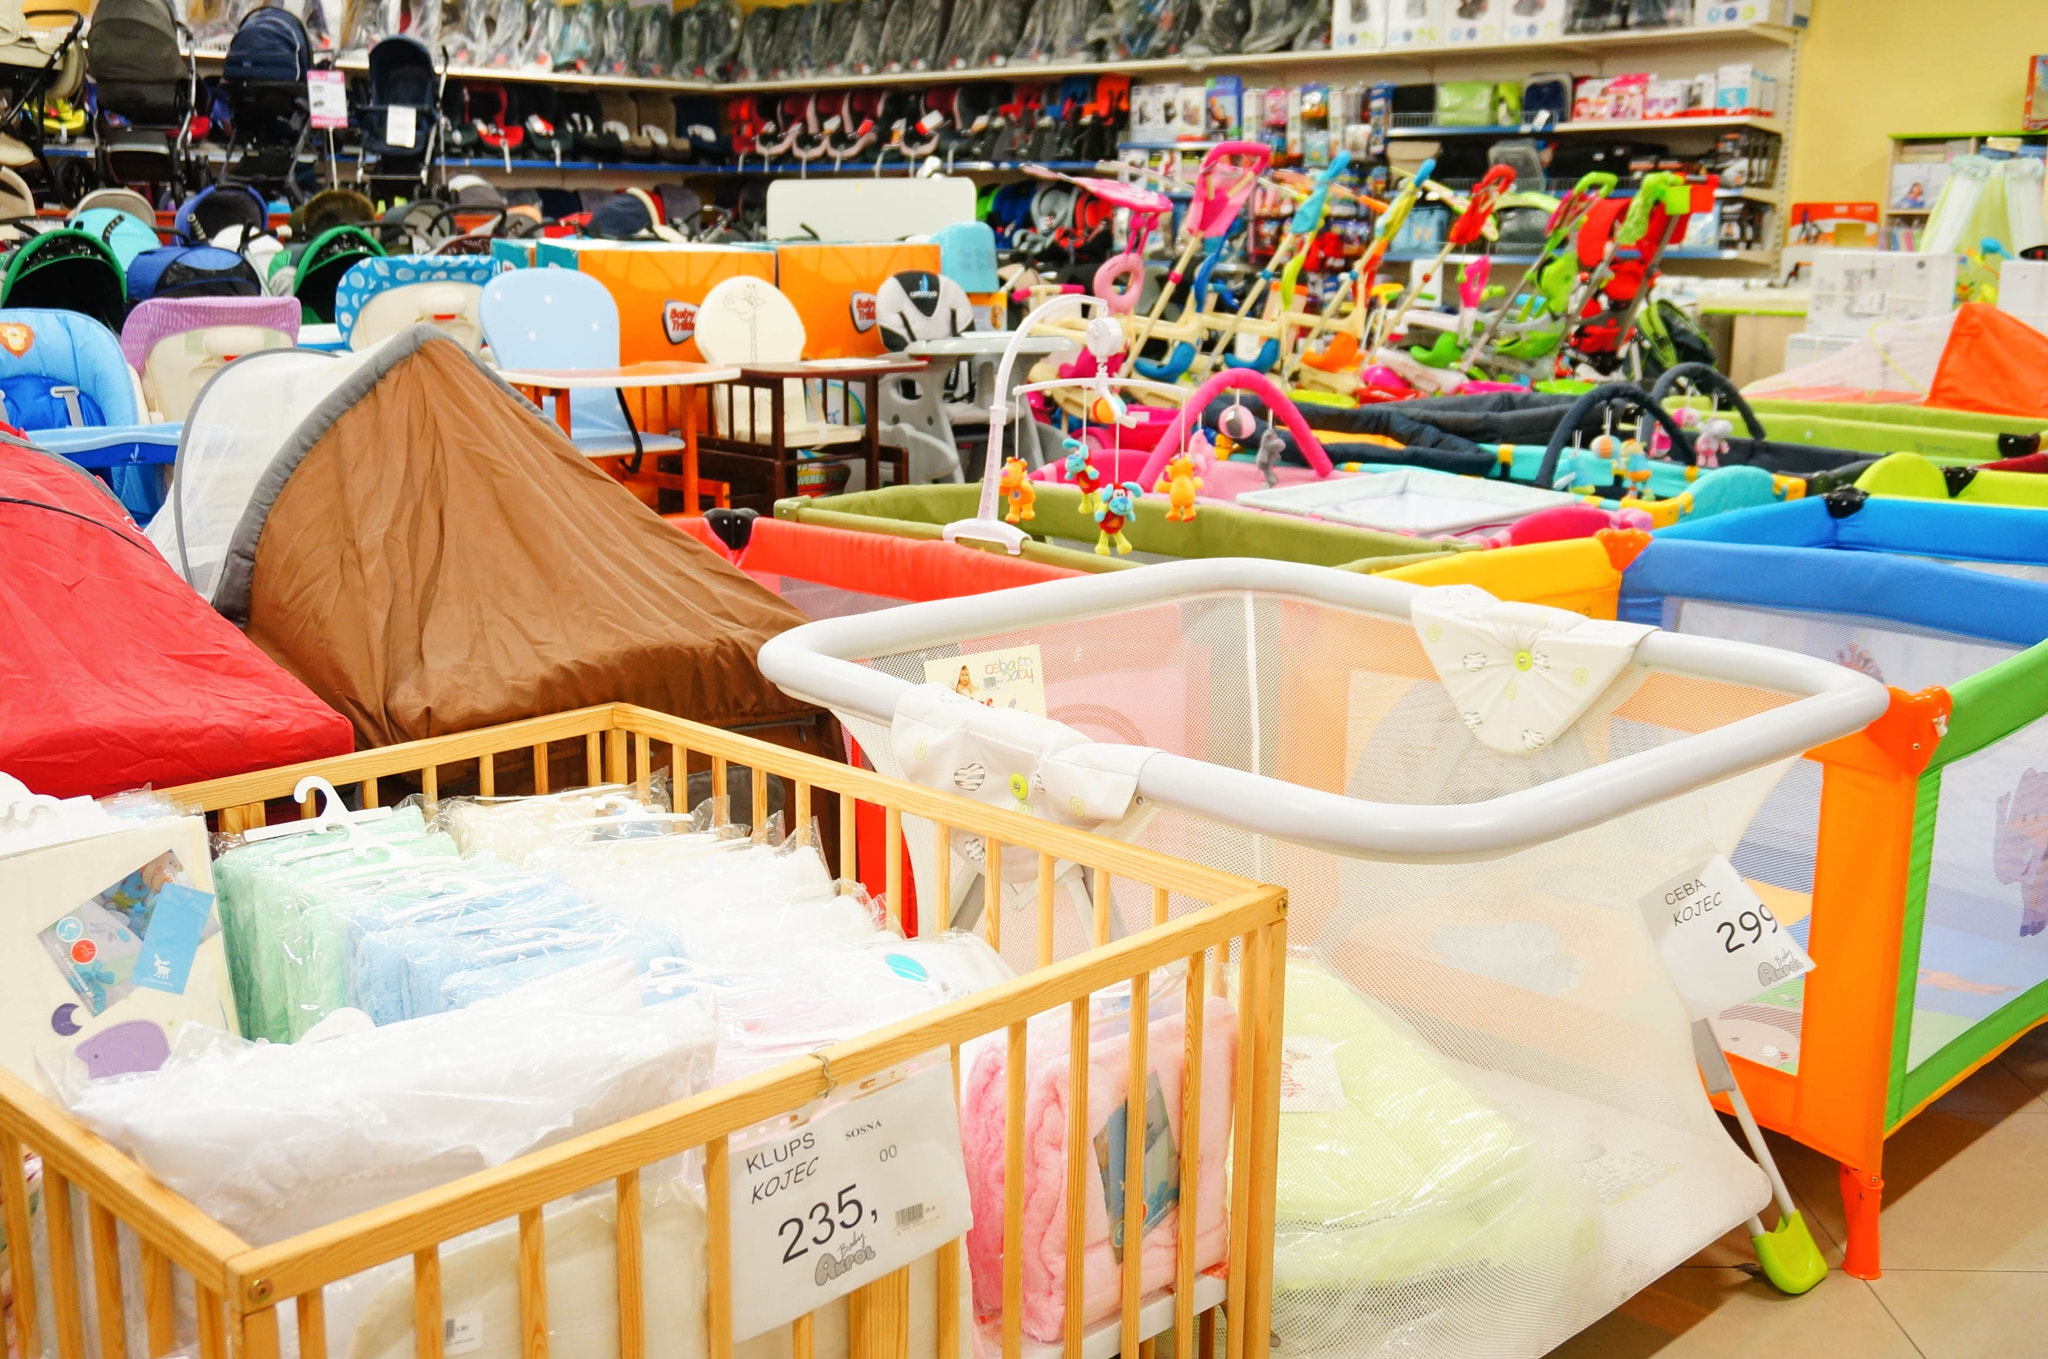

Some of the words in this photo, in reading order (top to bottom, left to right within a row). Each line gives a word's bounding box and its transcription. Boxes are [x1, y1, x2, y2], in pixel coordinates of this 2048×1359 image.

[670, 307, 696, 322] Baby
[1664, 878, 1707, 906] CEBA
[1672, 891, 1723, 927] KOJEC
[1716, 903, 1779, 954] 299
[844, 1120, 882, 1141] SOSNA
[745, 1132, 816, 1174] KLUPS
[751, 1156, 819, 1205] KOJEC
[777, 1183, 879, 1265] 235,
[837, 1230, 867, 1260] Baby
